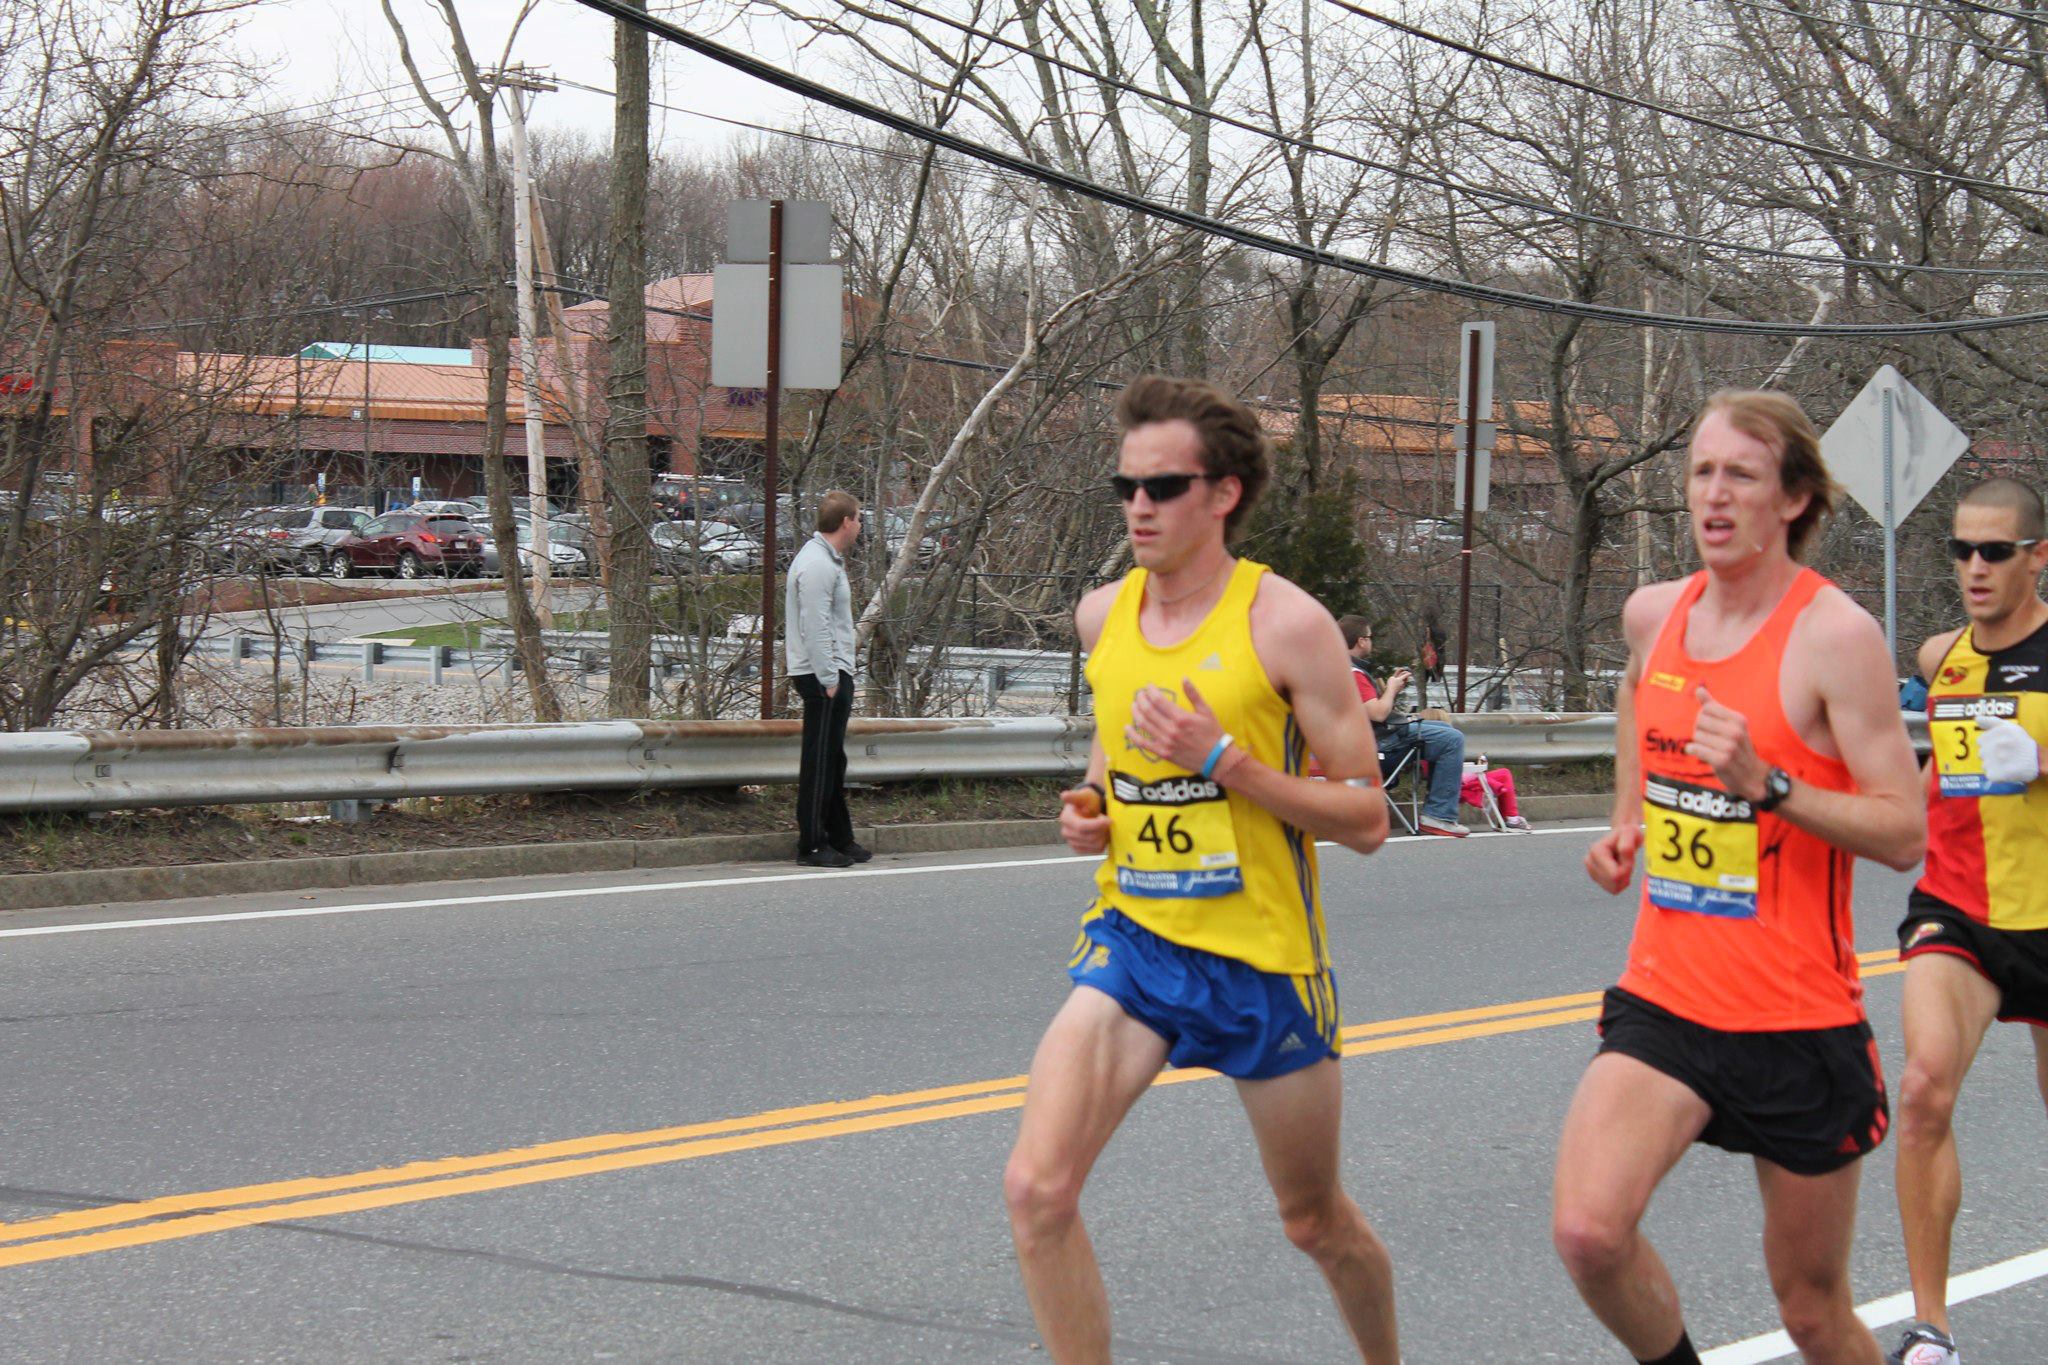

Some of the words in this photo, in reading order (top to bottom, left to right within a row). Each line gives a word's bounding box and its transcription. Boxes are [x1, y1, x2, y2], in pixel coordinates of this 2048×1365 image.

[1965, 698, 2015, 717] adidas
[1142, 780, 1219, 803] adidas
[1678, 790, 1751, 819] adidas
[1137, 813, 1194, 854] 46
[1661, 818, 1714, 870] 36
